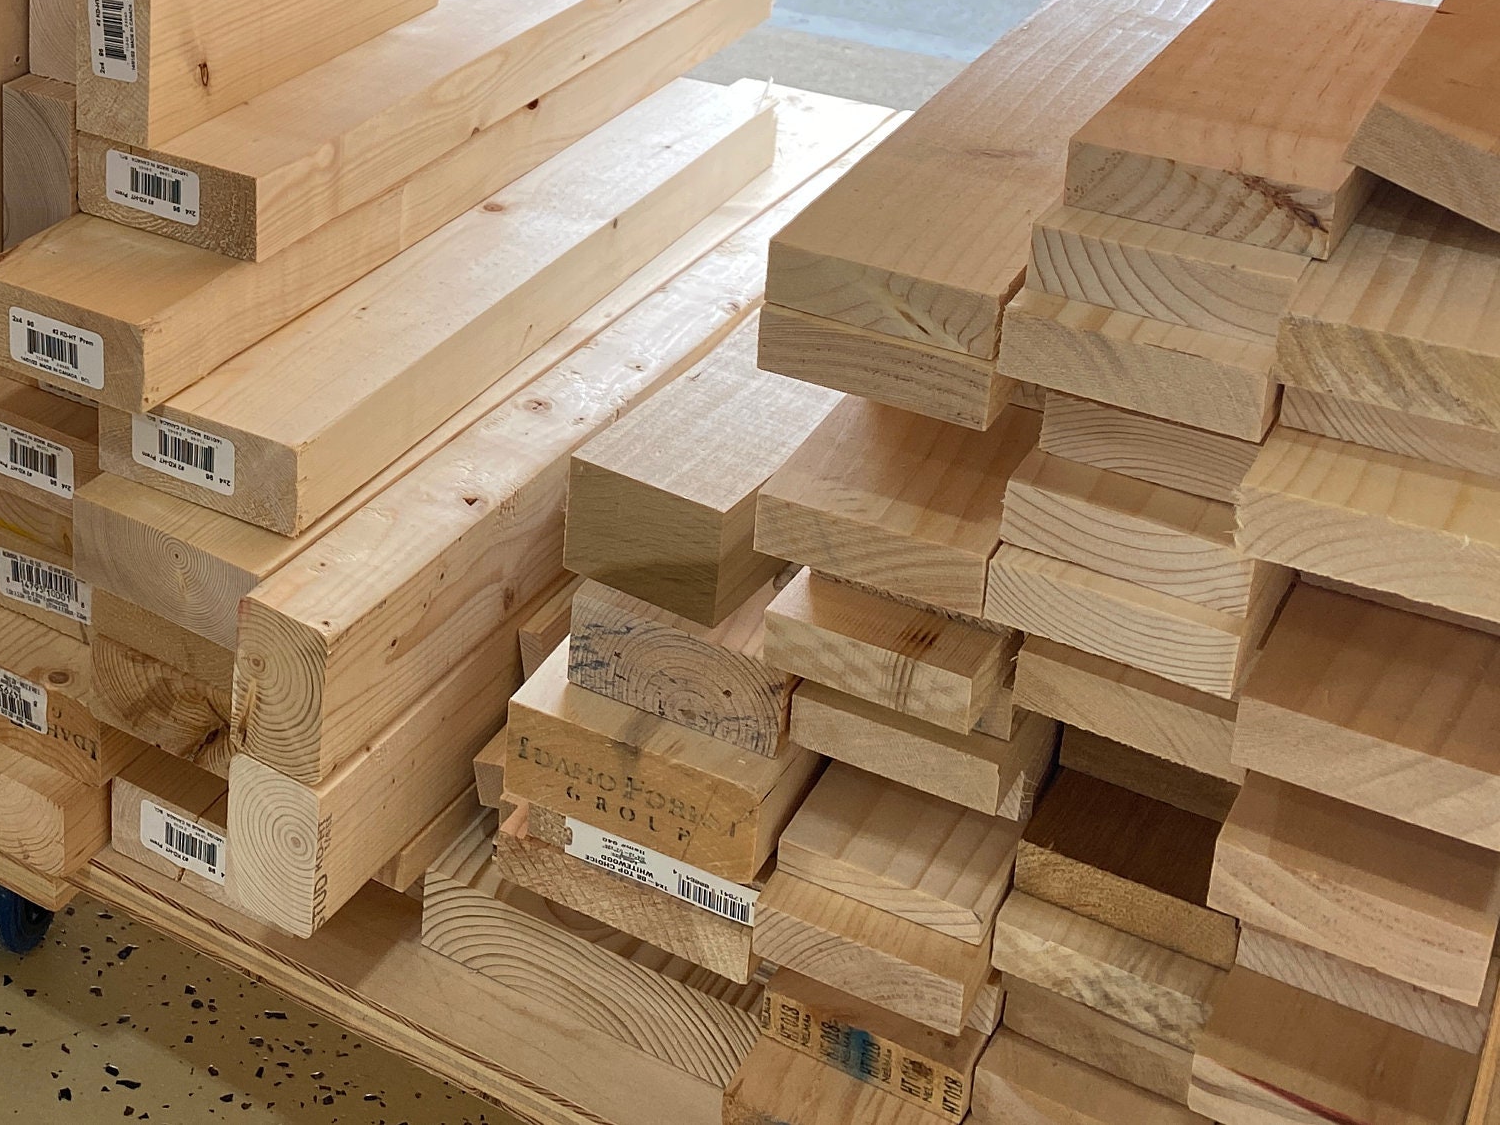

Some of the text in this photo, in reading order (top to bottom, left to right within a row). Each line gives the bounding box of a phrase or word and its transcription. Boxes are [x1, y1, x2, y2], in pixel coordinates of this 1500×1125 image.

[141, 450, 156, 461] Prem
[585, 853, 616, 871] CHOICE
[600, 852, 653, 879] WHITEWOOD
[618, 867, 633, 877] TOP
